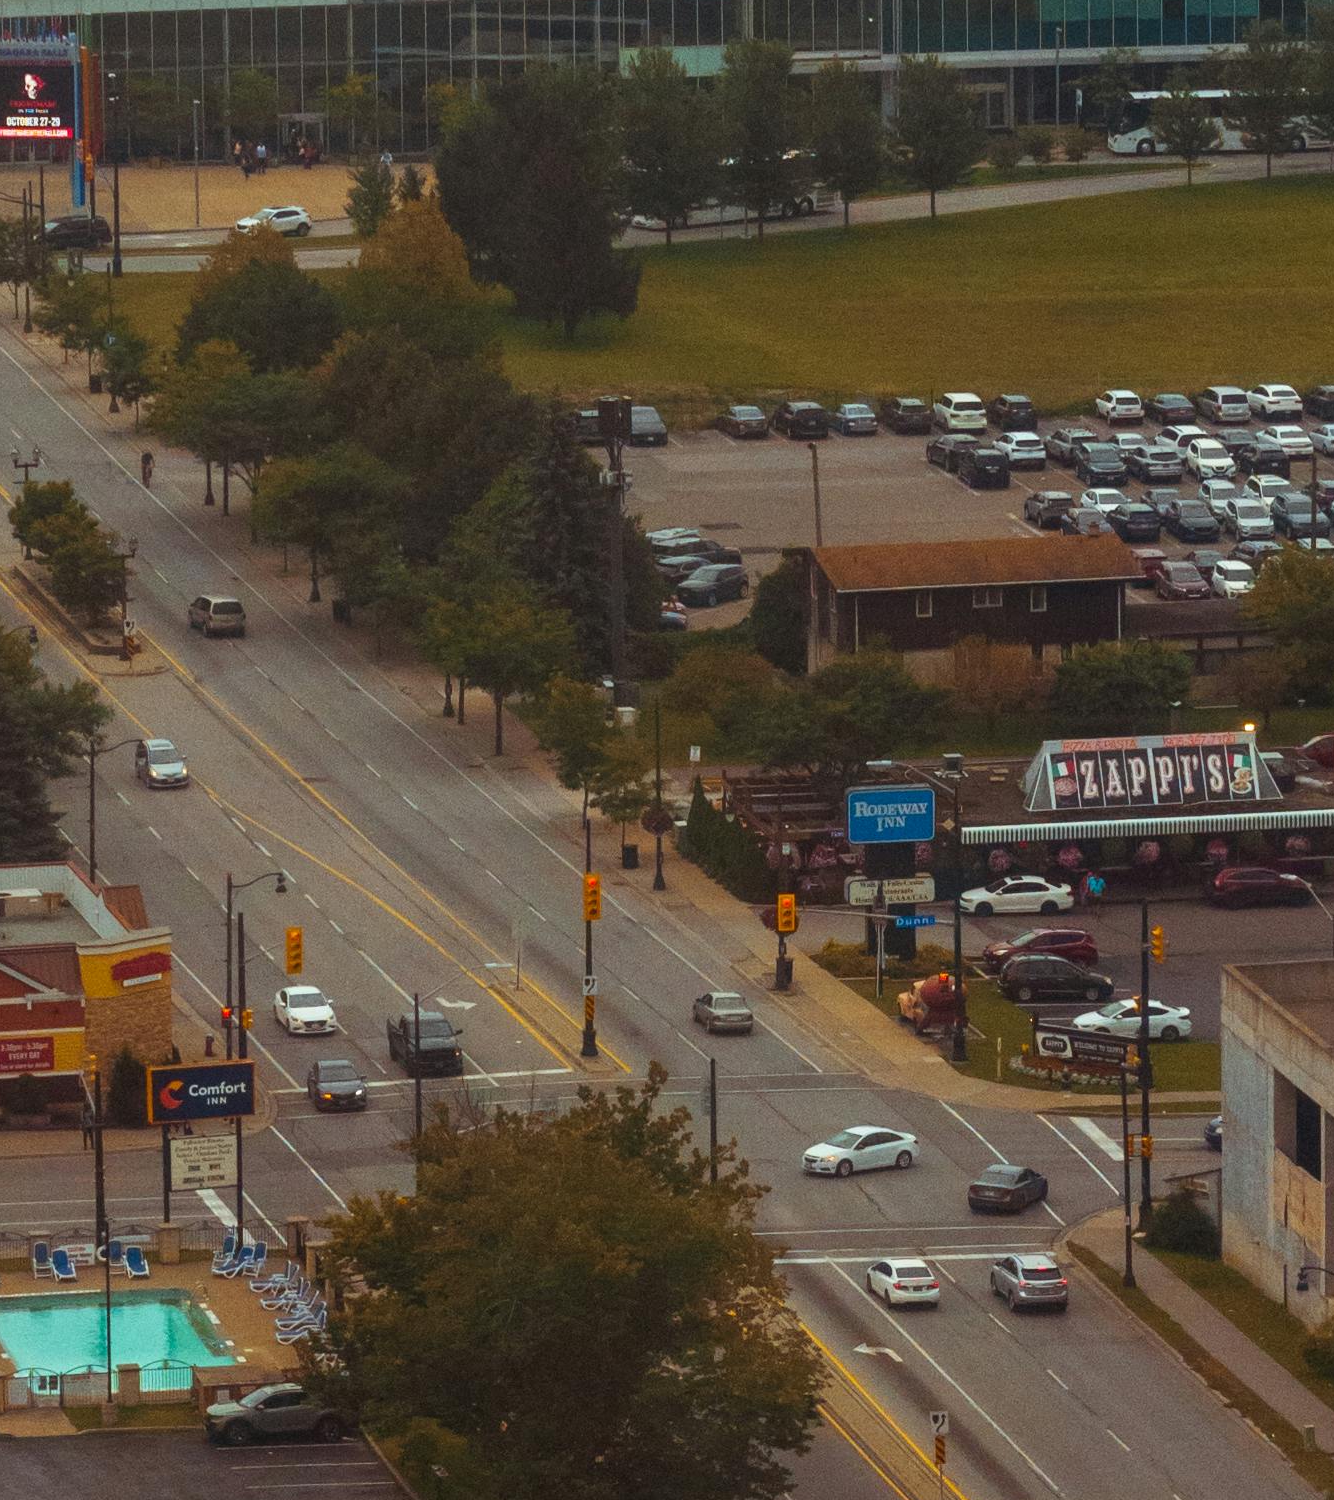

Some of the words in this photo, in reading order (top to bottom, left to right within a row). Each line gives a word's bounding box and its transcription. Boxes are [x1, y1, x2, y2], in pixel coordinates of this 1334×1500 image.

[6, 117, 38, 127] OCTOBER
[1079, 754, 1223, 799] ZAPPI'S
[854, 801, 928, 817] RODEWAY
[876, 816, 907, 832] INN
[896, 917, 929, 927] Dunn
[188, 1081, 247, 1097] Comfort
[207, 1096, 227, 1105] INN
